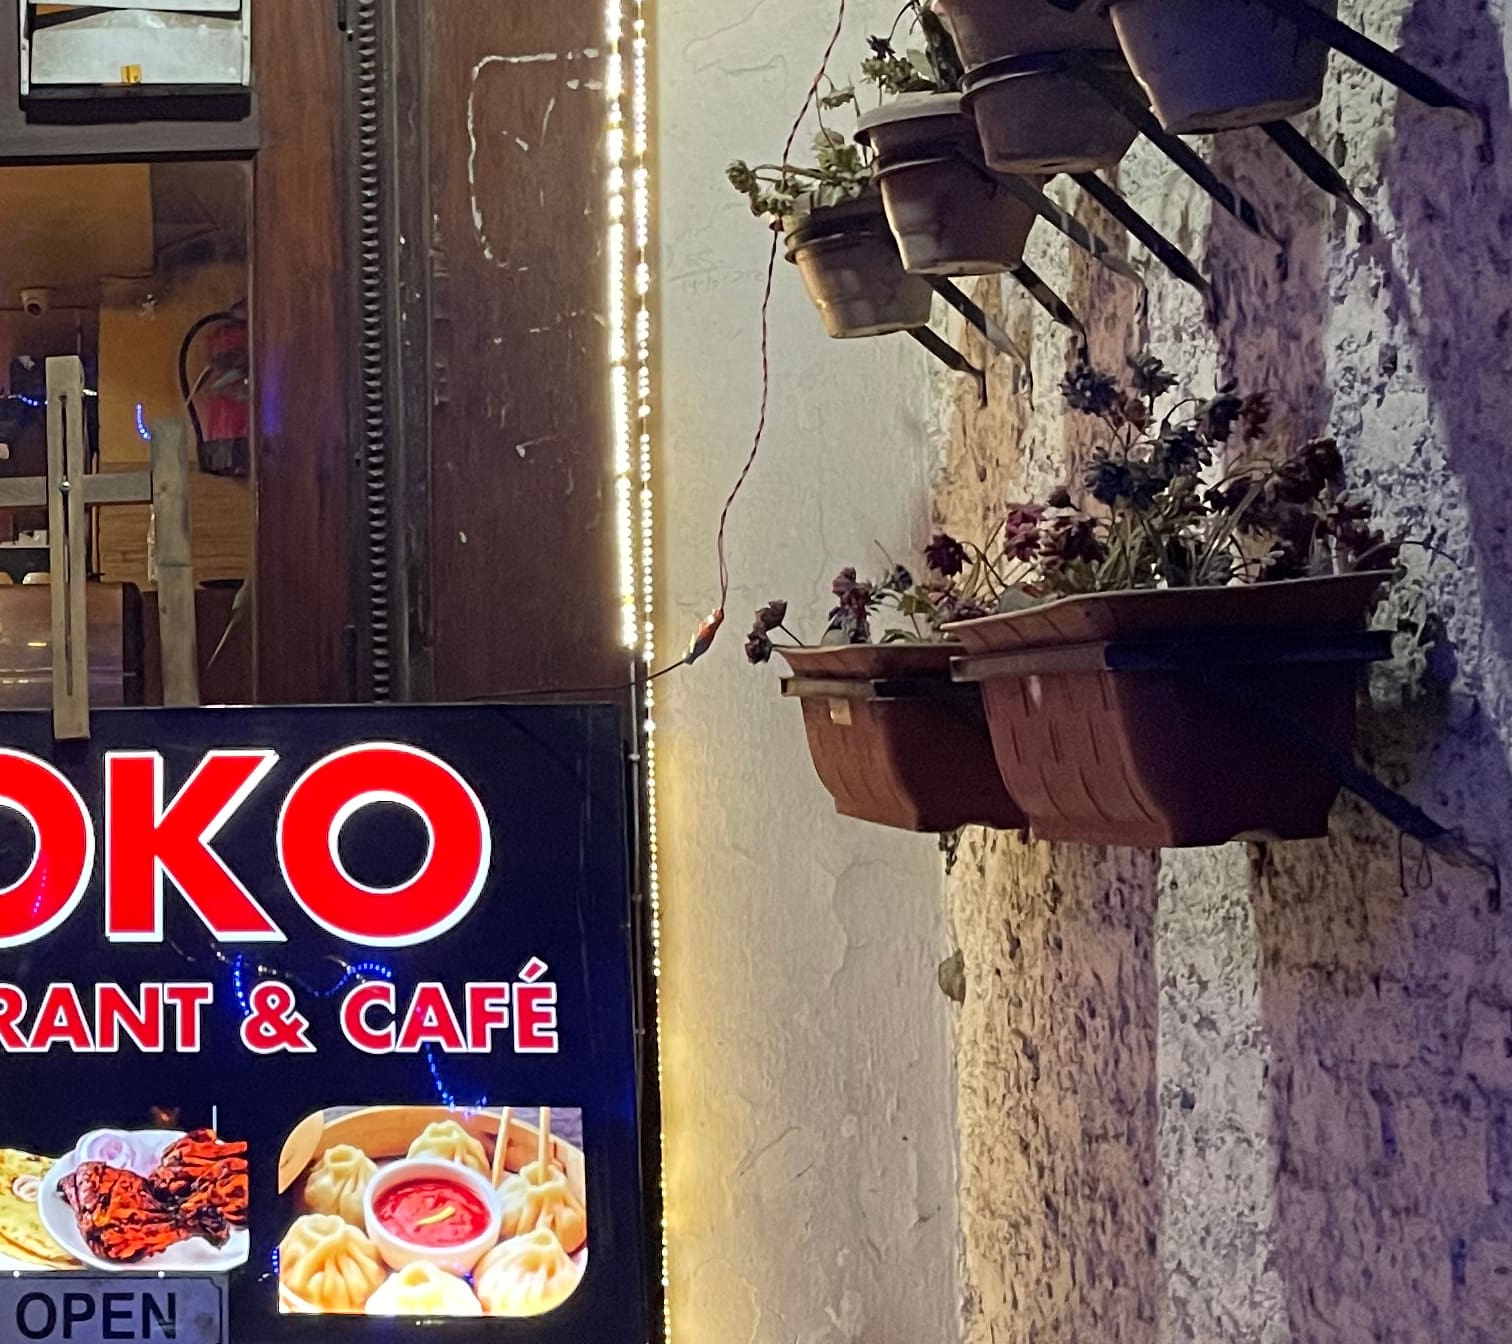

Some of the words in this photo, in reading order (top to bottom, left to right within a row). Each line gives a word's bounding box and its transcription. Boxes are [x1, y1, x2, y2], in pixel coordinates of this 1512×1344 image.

[240, 983, 314, 1054] &
[340, 958, 560, 1054] CAFÉ
[16, 1292, 176, 1340] OPEN
